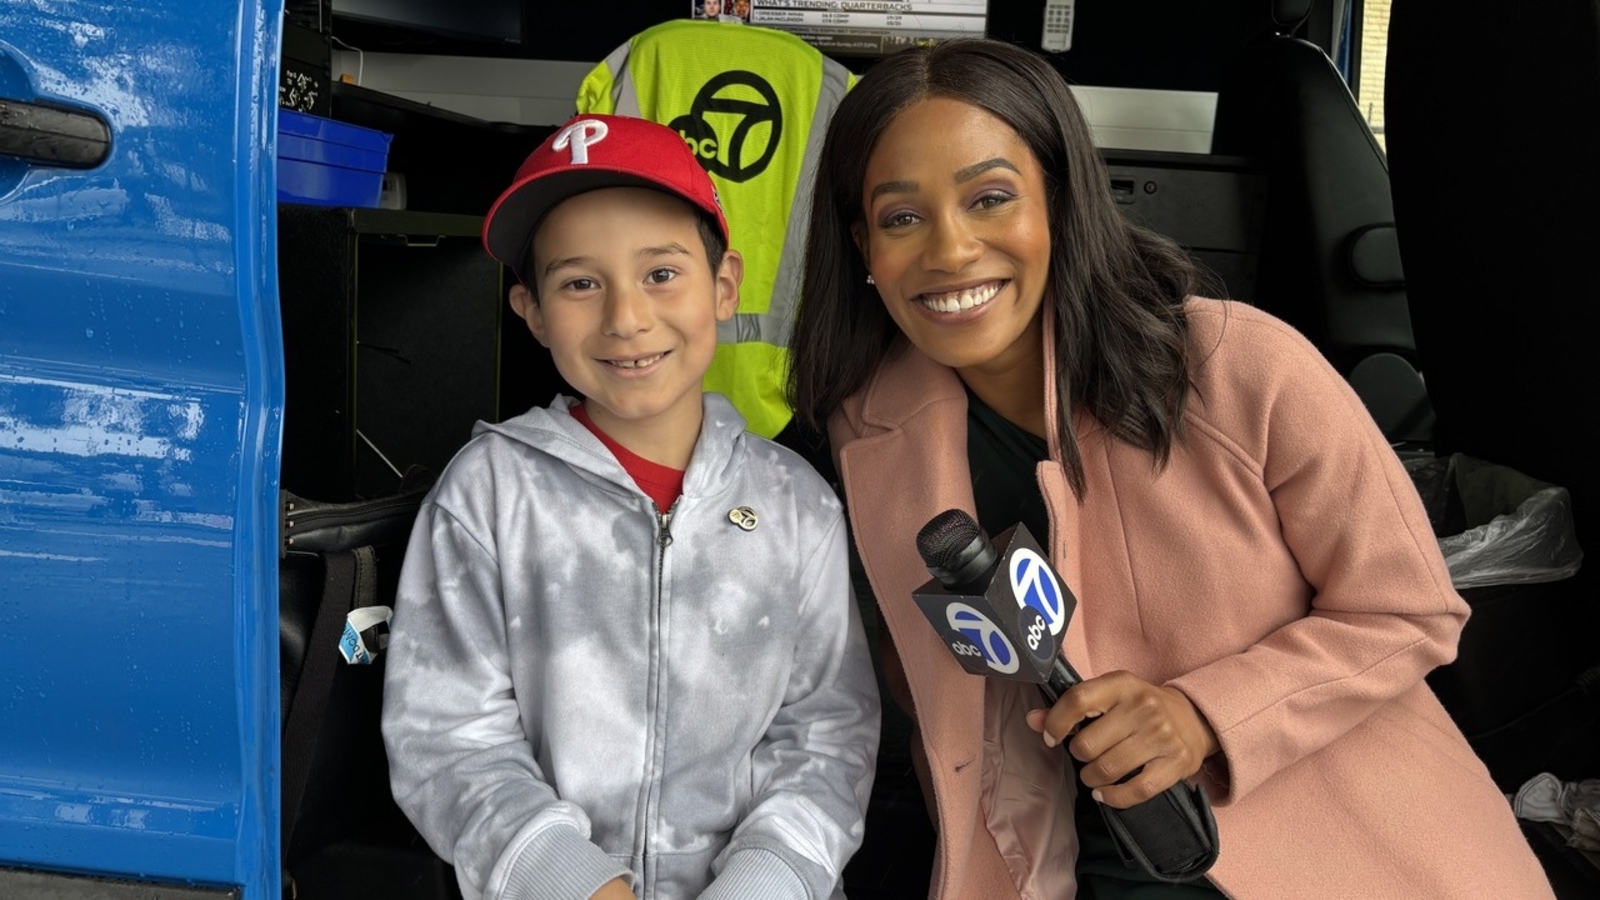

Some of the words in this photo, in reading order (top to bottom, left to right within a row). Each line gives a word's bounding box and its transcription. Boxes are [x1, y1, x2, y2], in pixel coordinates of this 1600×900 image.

[840, 2, 912, 12] QUARTERBACKS
[552, 119, 608, 165] P
[1027, 615, 1046, 650] abc
[952, 641, 982, 657] abc
